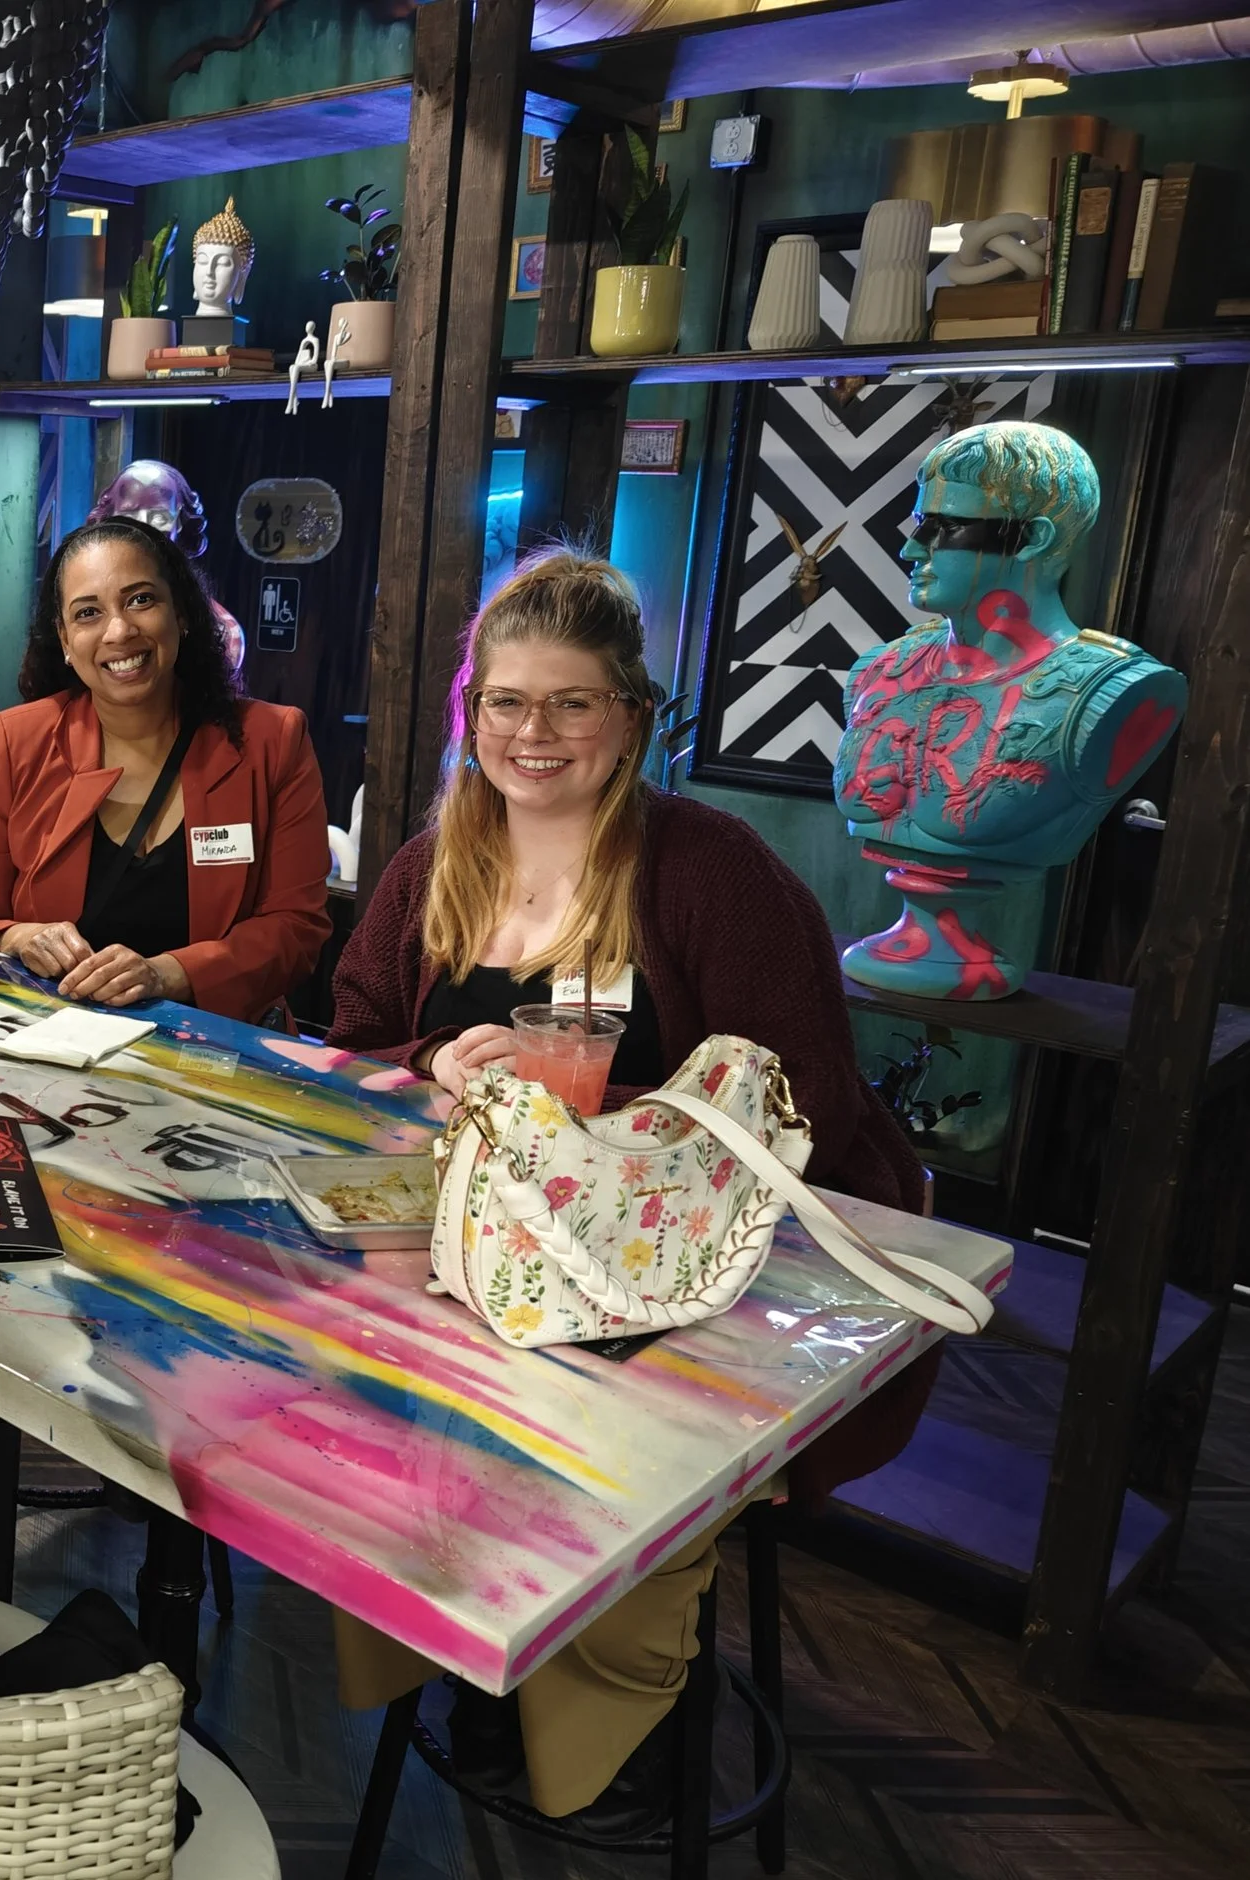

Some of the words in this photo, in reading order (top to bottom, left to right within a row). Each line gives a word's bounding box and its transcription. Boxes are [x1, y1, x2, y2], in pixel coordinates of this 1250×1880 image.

[193, 828, 229, 843] cypclub
[1, 1179, 21, 1205] BLAME
[9, 1205, 25, 1216] IT
[12, 1216, 30, 1229] ON
